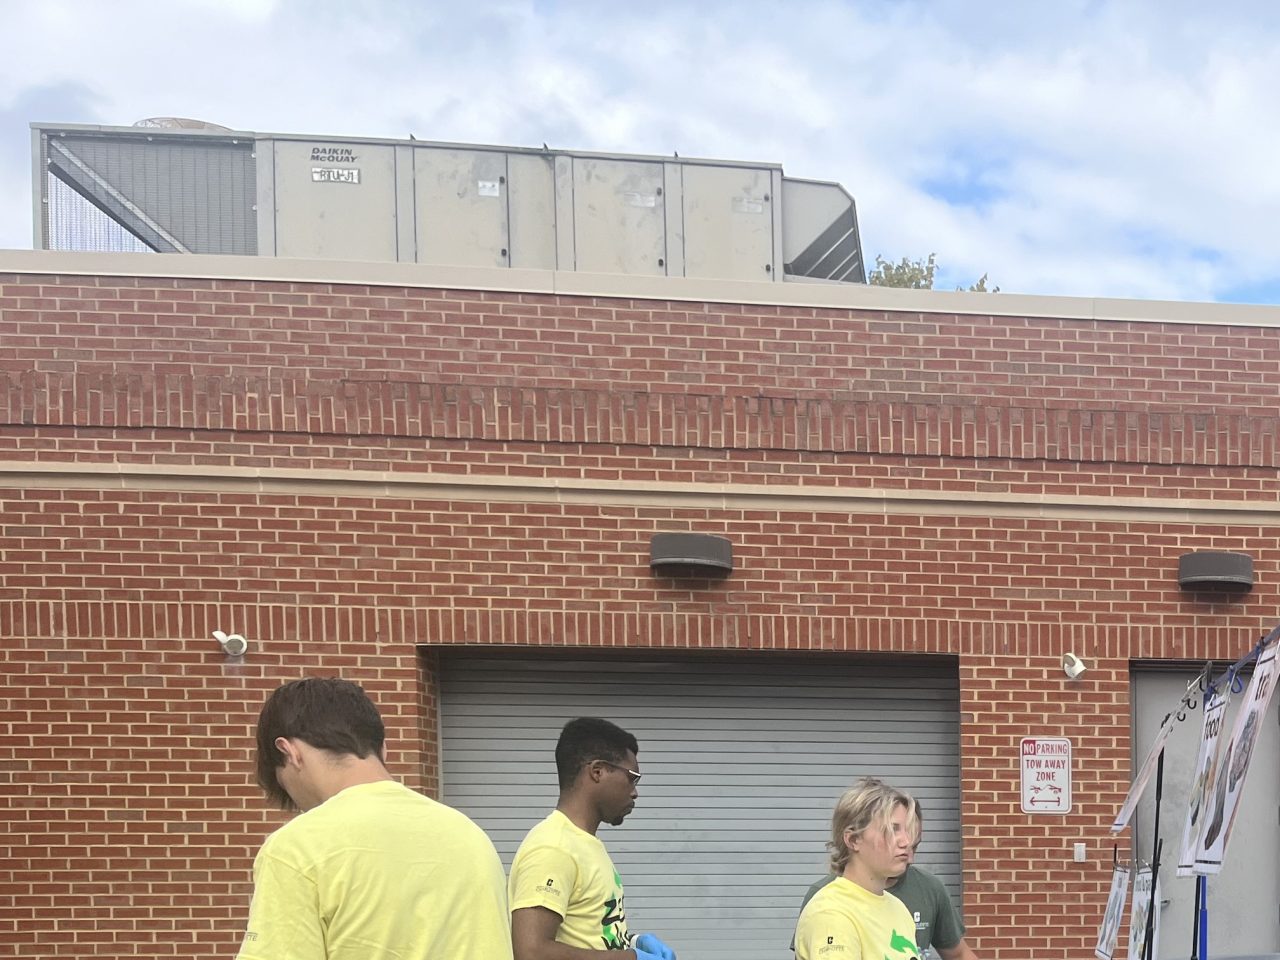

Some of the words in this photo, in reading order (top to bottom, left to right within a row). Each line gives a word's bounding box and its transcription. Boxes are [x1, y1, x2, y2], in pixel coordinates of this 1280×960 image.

[310, 154, 357, 163] McQUAY
[1023, 743, 1034, 754] NO
[1036, 743, 1067, 754] PARKING
[1026, 759, 1041, 769] TOW
[1045, 759, 1065, 769] AWAY
[1036, 771, 1055, 781] ZONE
